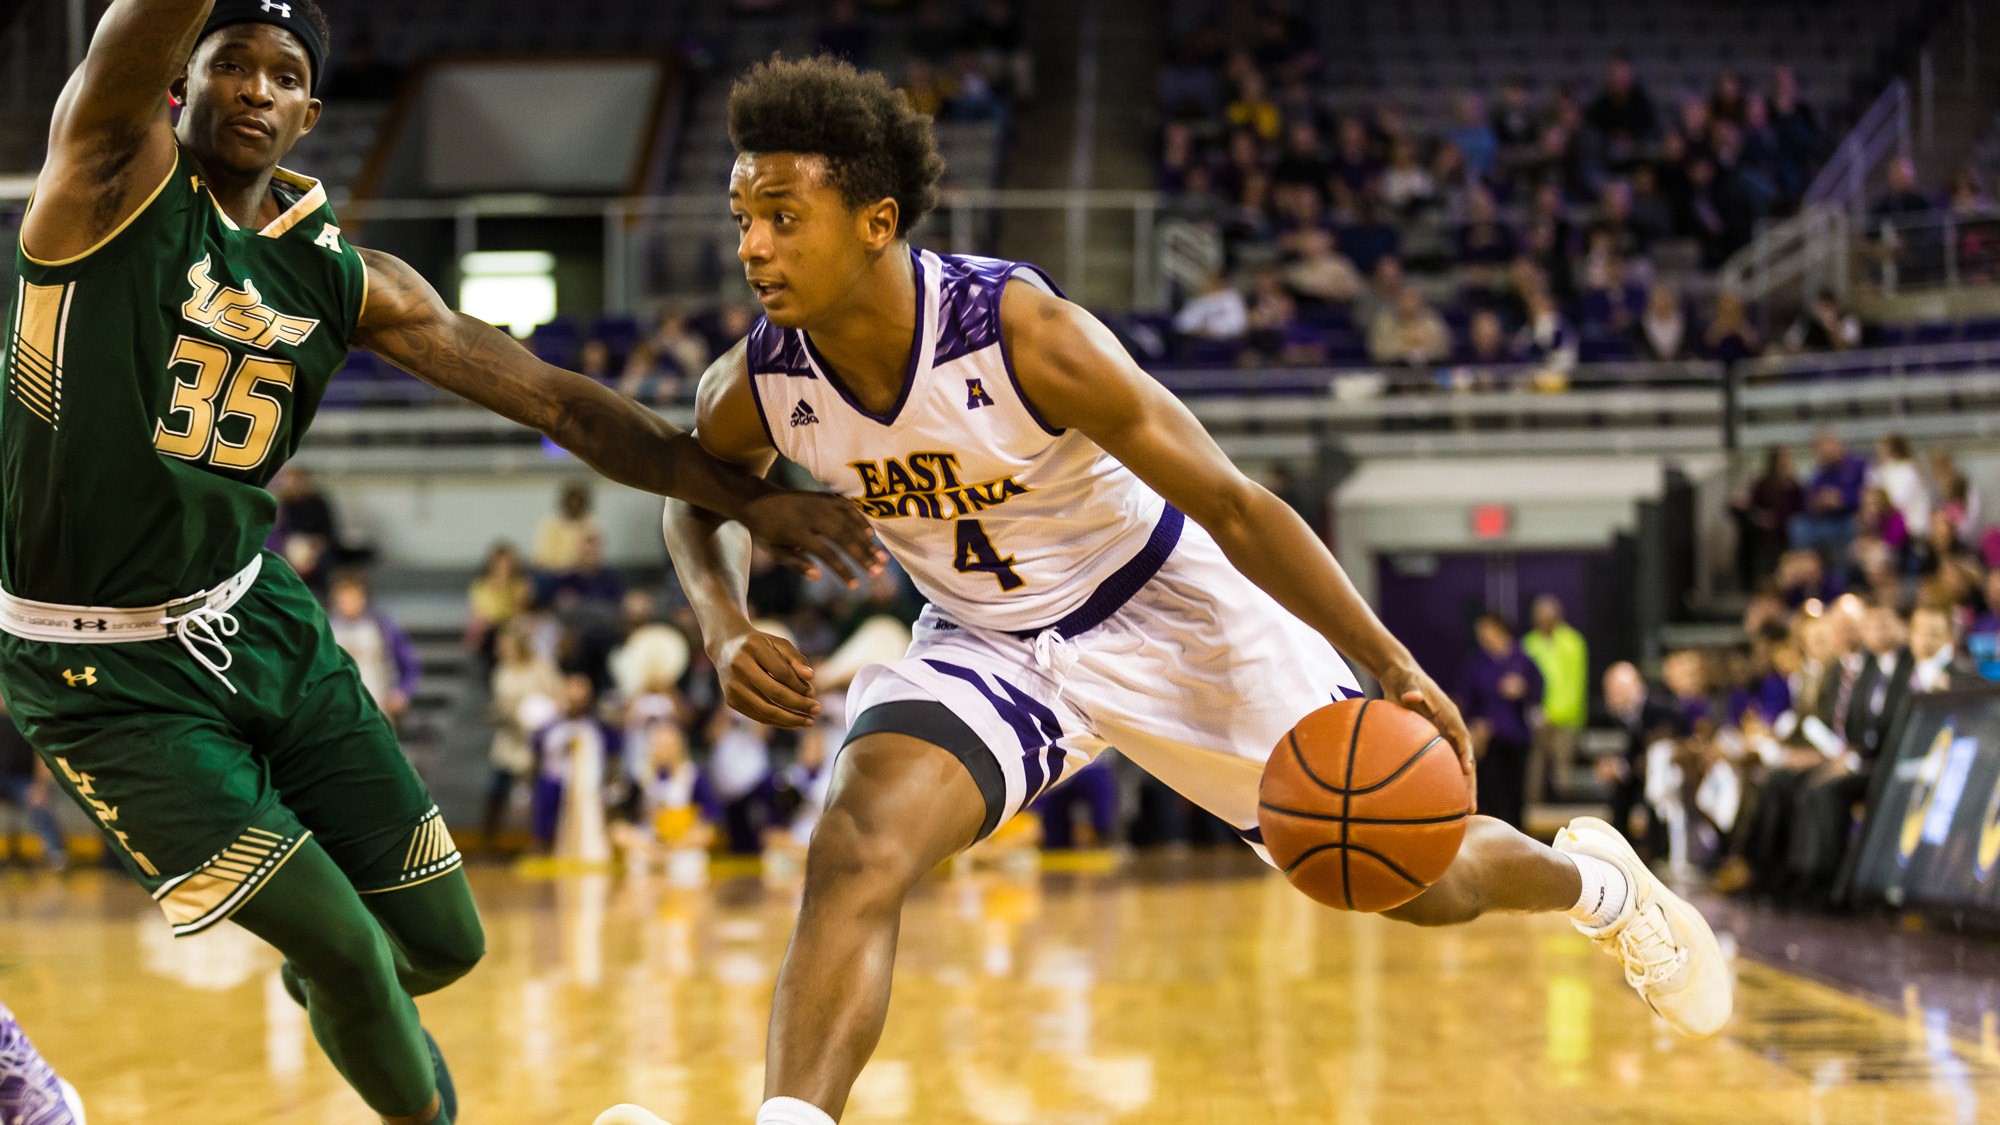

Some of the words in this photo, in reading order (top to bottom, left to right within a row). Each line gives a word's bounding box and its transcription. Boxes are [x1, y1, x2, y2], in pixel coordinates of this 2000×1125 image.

[182, 253, 320, 350] USF
[153, 334, 297, 471] 35
[790, 414, 820, 428] adida
[845, 452, 963, 499] EAST
[851, 474, 1037, 521] ROLINA
[952, 519, 1027, 593] 4
